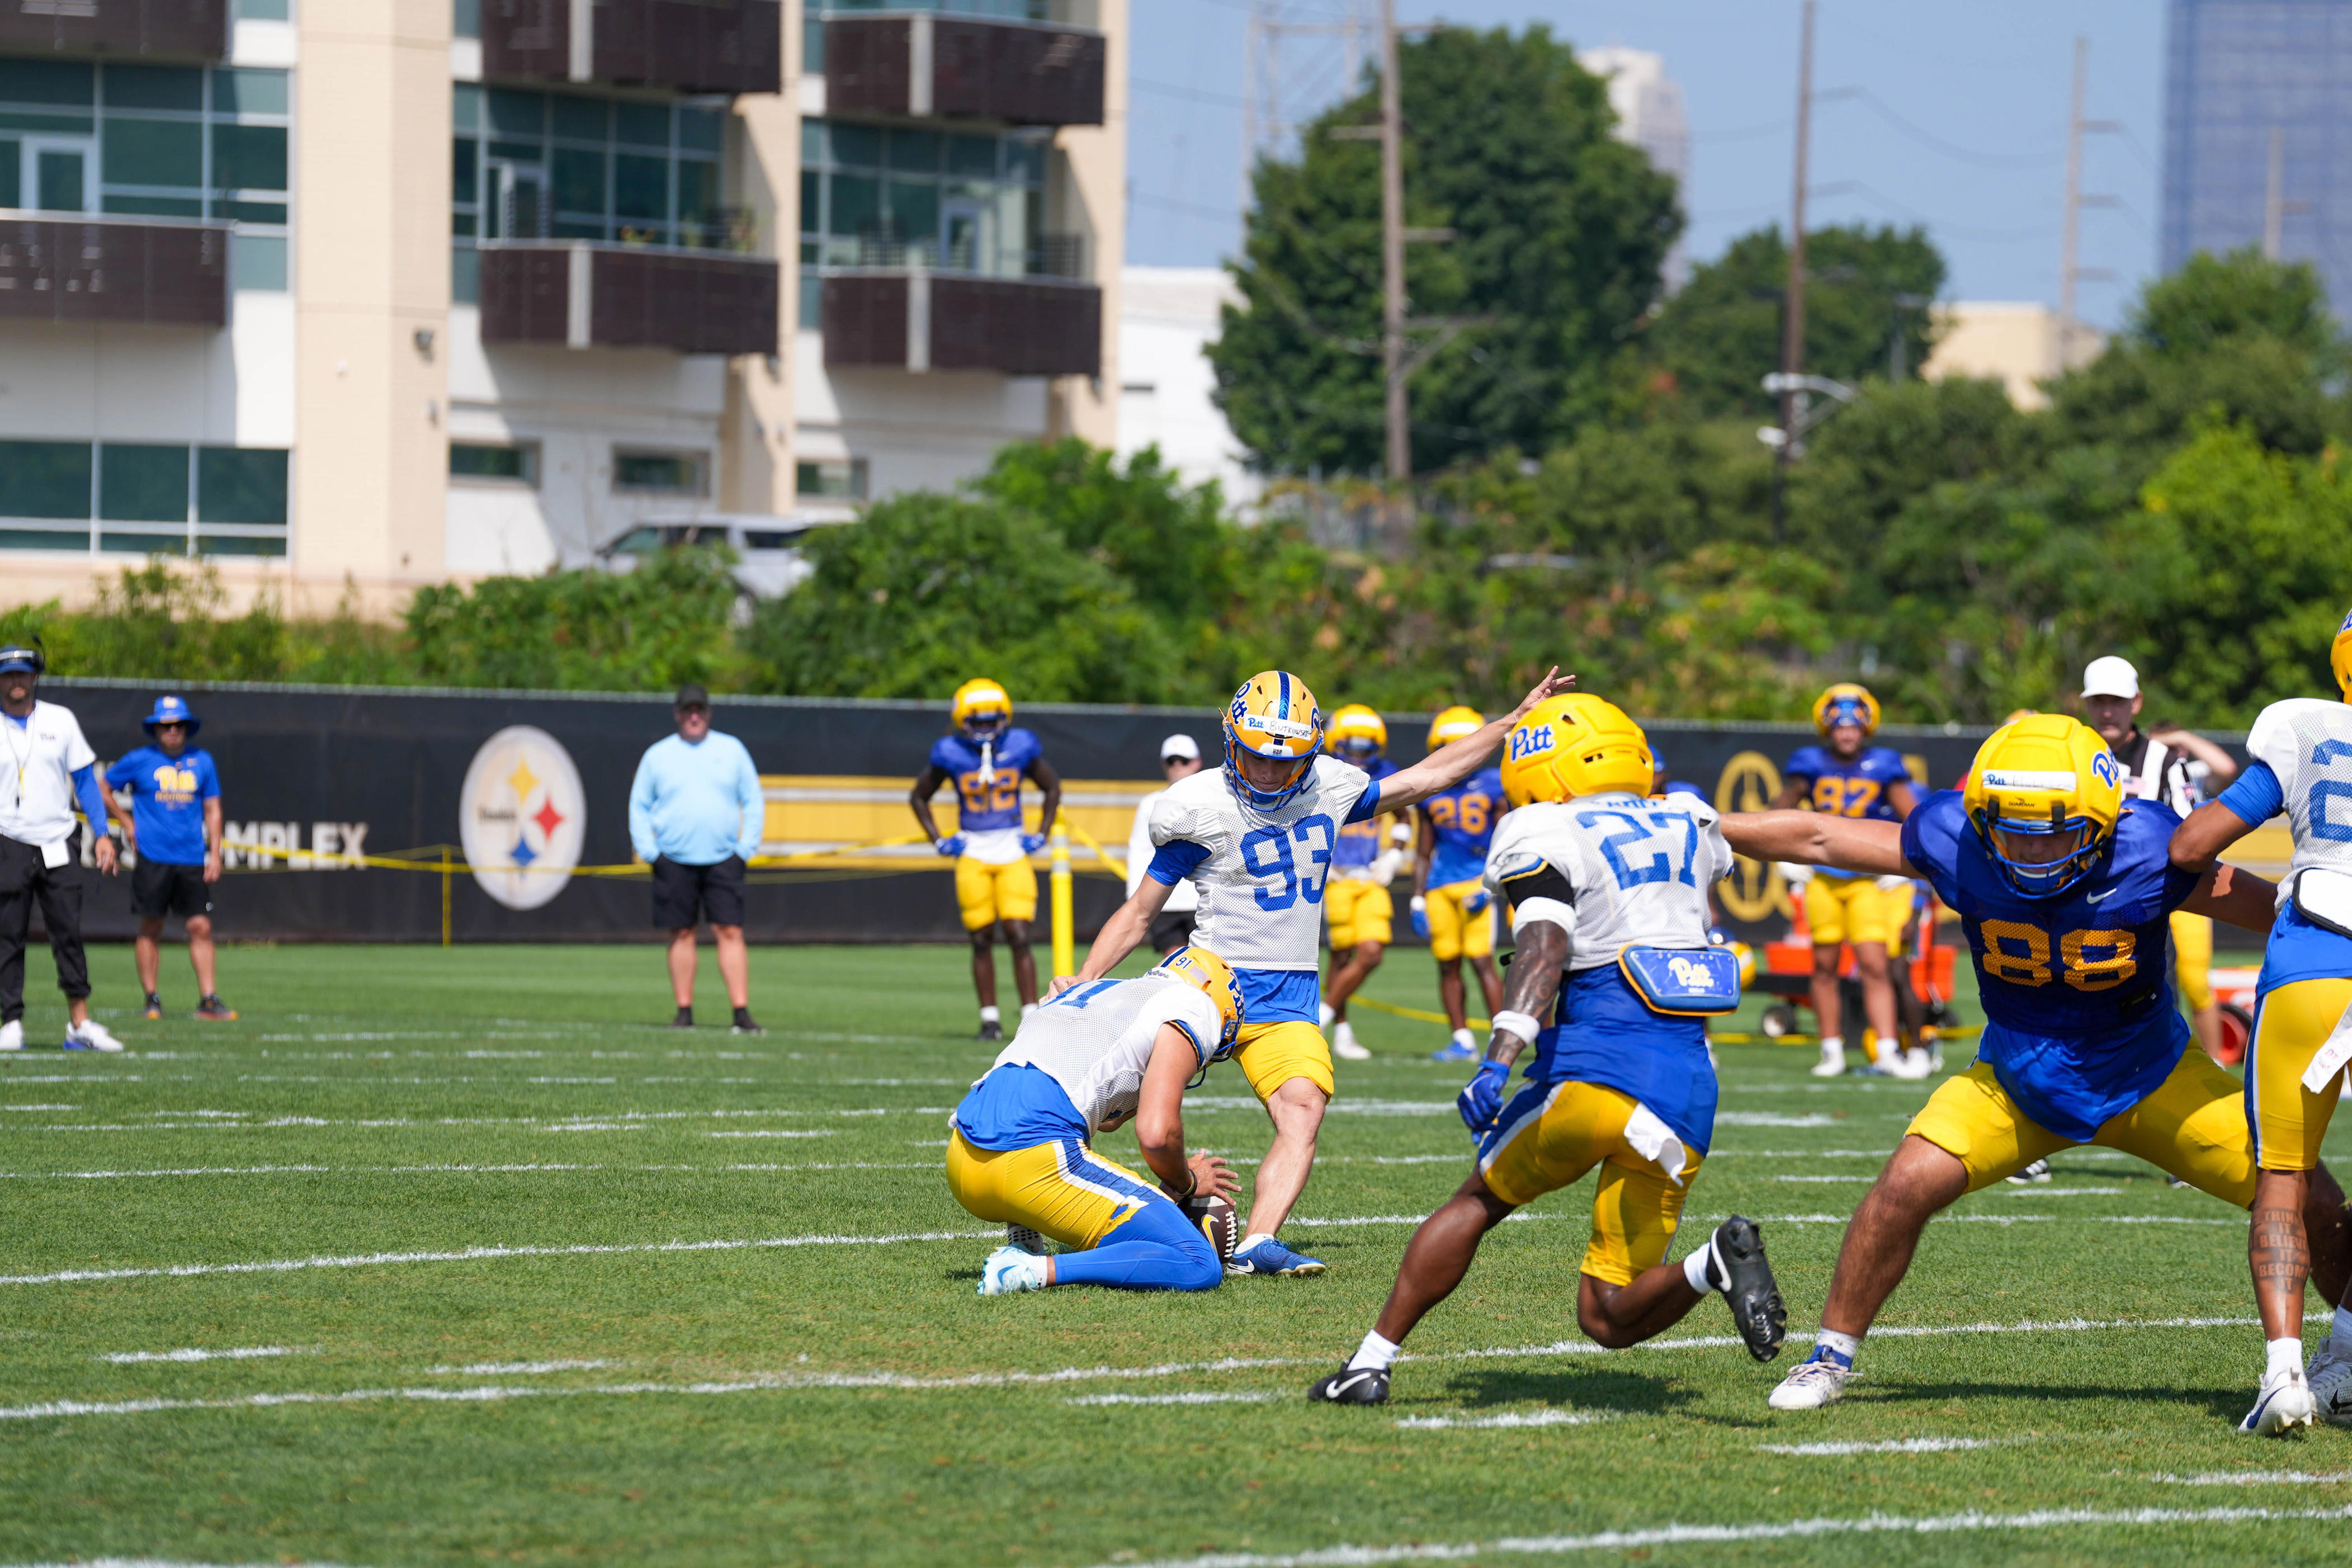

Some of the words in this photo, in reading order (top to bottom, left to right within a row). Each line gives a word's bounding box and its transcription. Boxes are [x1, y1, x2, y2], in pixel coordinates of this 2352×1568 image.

[1232, 682, 1251, 725] Pitt
[1248, 717, 1264, 729] Pitt
[1511, 725, 1554, 761] Pitt
[1812, 776, 1881, 817] 87
[1986, 774, 2006, 786] Pitt
[1428, 793, 1491, 835] 26
[204, 820, 369, 871] MPLEX
[1240, 813, 1335, 911] 93
[1575, 811, 1698, 891] 27
[1175, 957, 1193, 969] 91
[1668, 956, 1715, 988] Pitt
[1980, 919, 2137, 991] 88
[2278, 1222, 2290, 1234] IT
[2280, 1249, 2292, 1262] IT
[2280, 1277, 2292, 1291] IT
